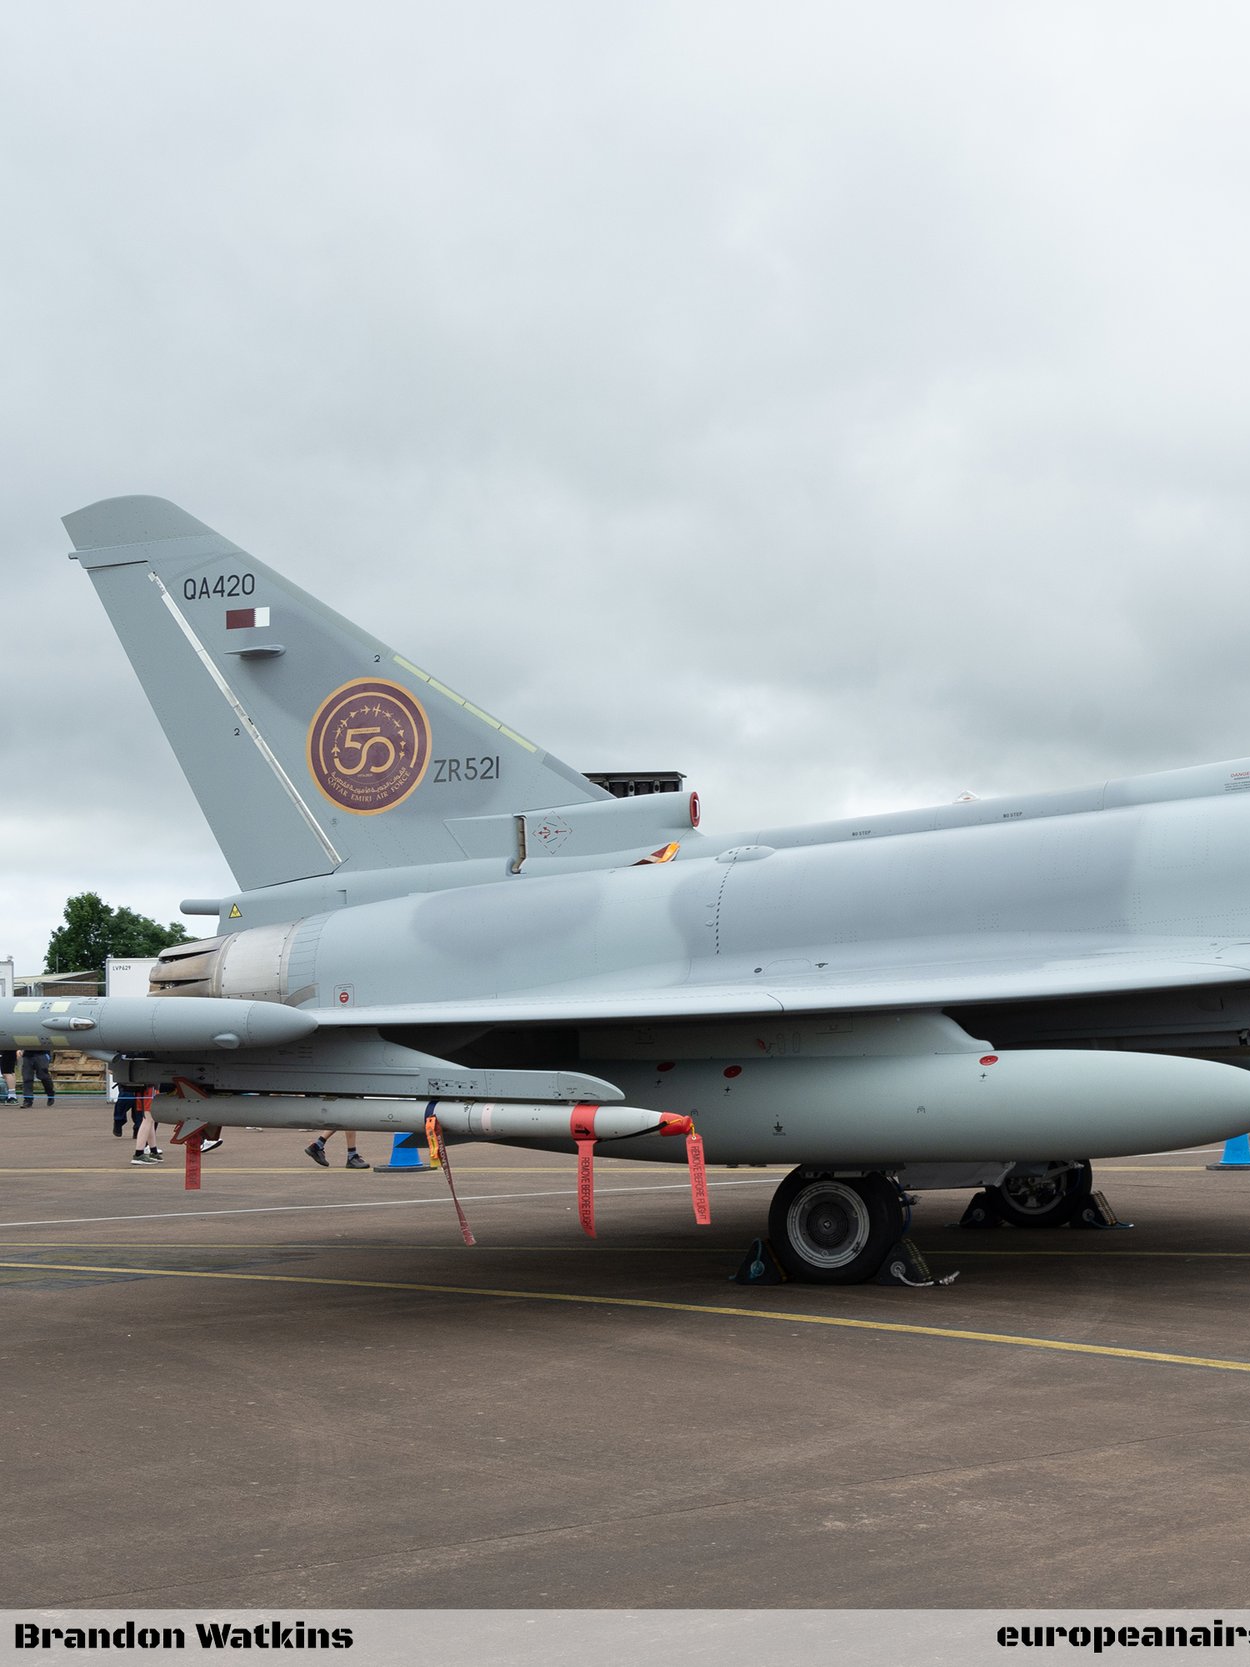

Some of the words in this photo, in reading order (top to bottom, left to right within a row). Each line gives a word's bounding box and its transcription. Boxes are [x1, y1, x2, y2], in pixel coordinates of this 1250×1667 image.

[184, 573, 255, 600] QA420
[373, 654, 381, 662] 2
[233, 727, 240, 736] 2
[332, 726, 396, 776] 50
[433, 756, 500, 783] ZR521
[327, 776, 349, 797] QATAR
[350, 793, 373, 802] EMIRI
[375, 790, 389, 801] AIR
[391, 771, 411, 793] FORCE
[580, 1156, 591, 1183] REMOVE
[690, 1145, 702, 1172] REMOVE
[581, 1183, 591, 1209] BEFORE
[693, 1172, 704, 1198] BEFORE
[582, 1209, 593, 1230] FLIGHT
[696, 1198, 707, 1220] FLIGHT
